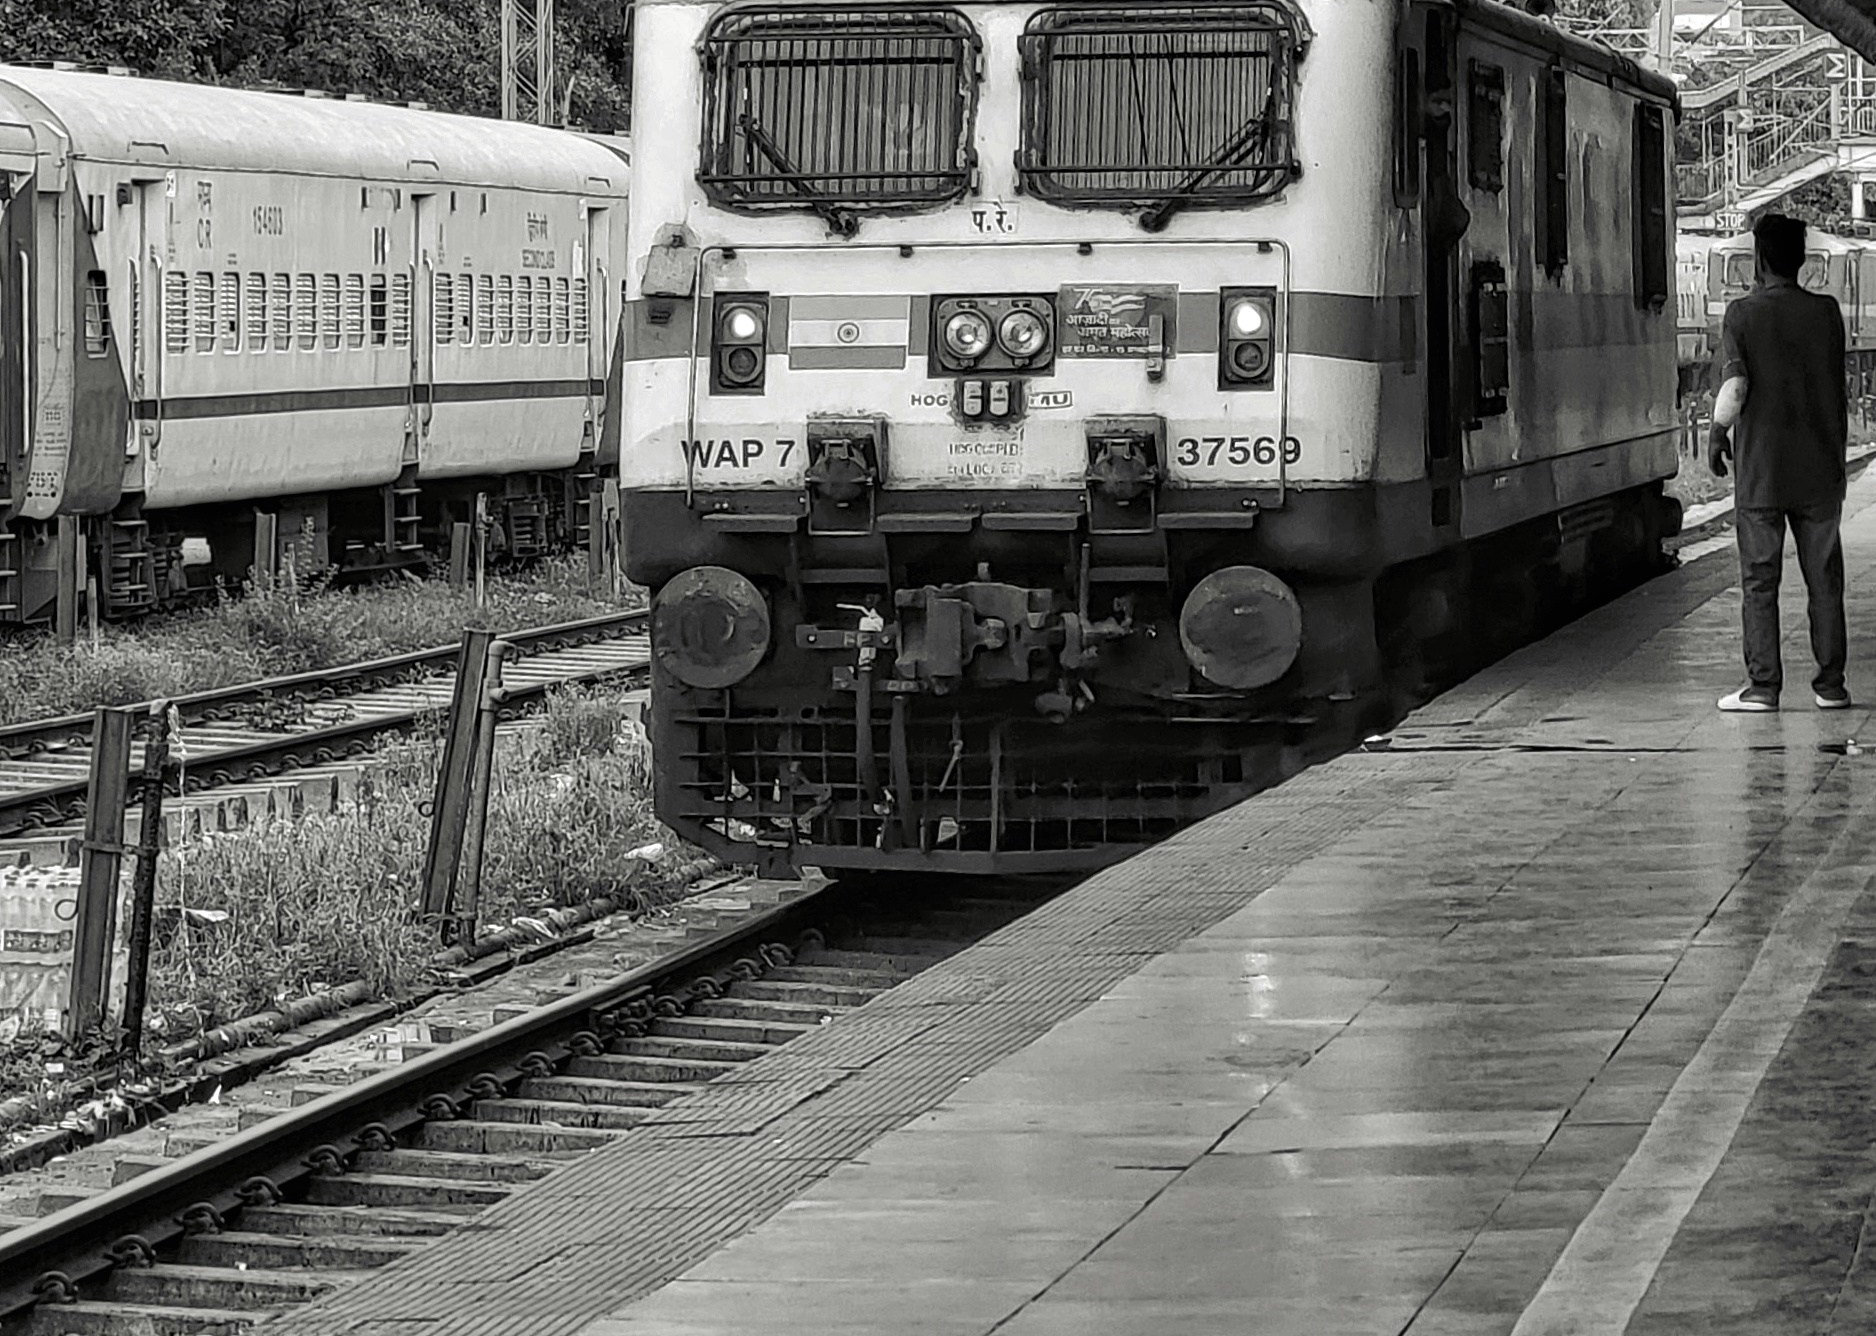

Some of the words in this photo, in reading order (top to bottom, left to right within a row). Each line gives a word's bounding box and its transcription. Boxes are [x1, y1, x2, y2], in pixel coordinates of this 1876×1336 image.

[1716, 213, 1746, 229] STOP
[911, 394, 949, 407] HOG
[680, 439, 764, 468] WAP
[775, 440, 796, 467] 7
[1177, 436, 1301, 466] 37569
